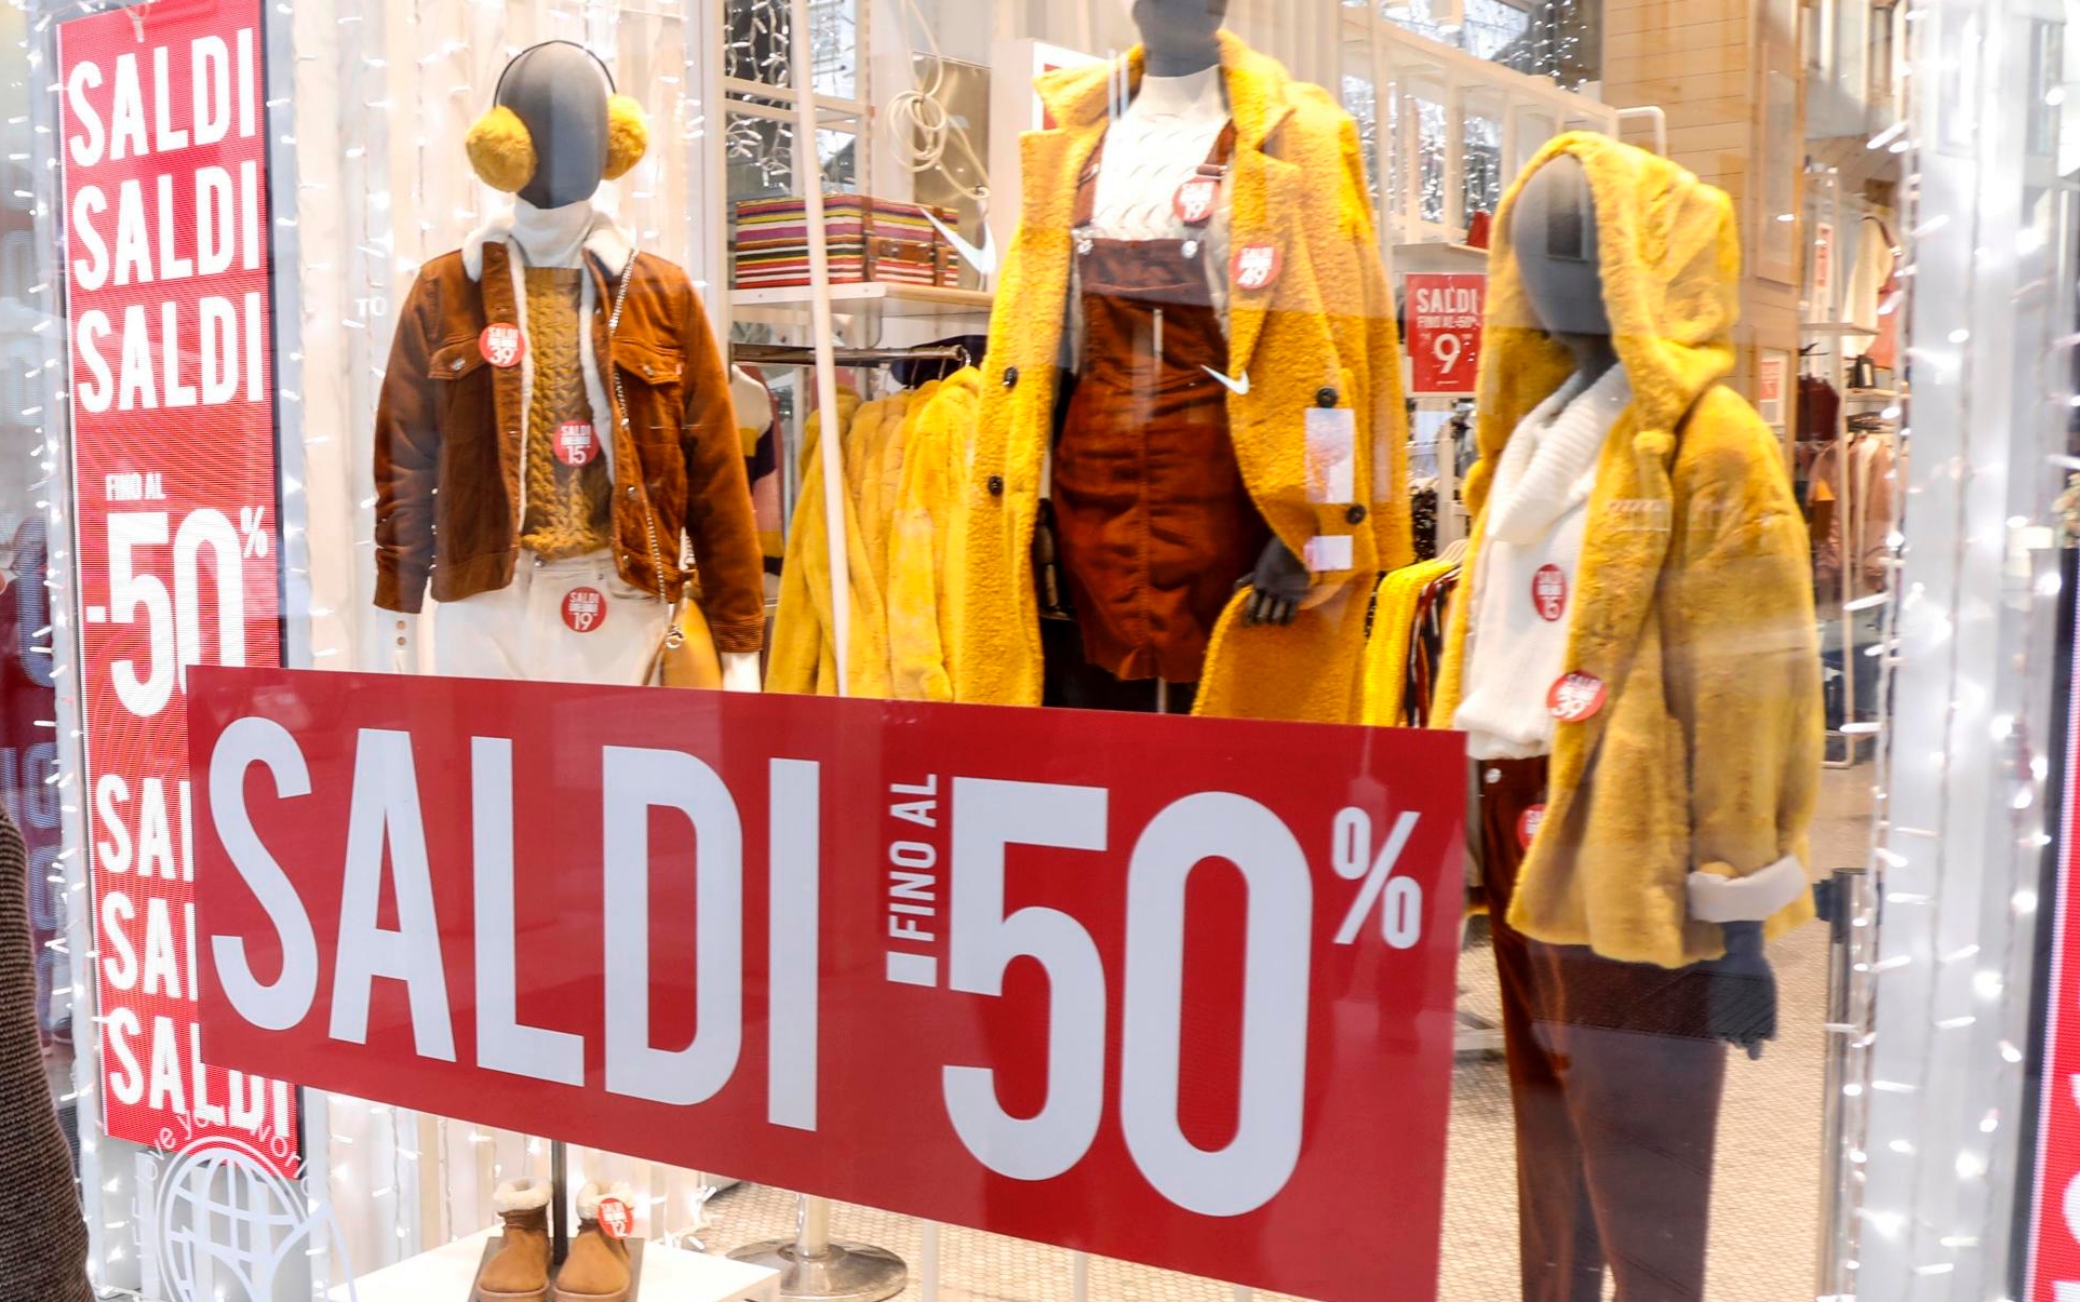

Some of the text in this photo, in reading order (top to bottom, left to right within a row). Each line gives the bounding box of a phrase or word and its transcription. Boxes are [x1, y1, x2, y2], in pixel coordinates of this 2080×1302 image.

[68, 28, 256, 167] SALDI
[72, 160, 260, 291] SALDI
[1237, 267, 1269, 285] 49
[1417, 288, 1477, 313] SALDI
[77, 292, 264, 413] SALDI
[489, 346, 515, 364] 39
[1434, 333, 1461, 374] 9
[566, 445, 587, 464] 15
[573, 612, 594, 630] 19
[1550, 695, 1587, 718] 39
[889, 774, 937, 941] FINO AL
[209, 716, 819, 1131] SALDI
